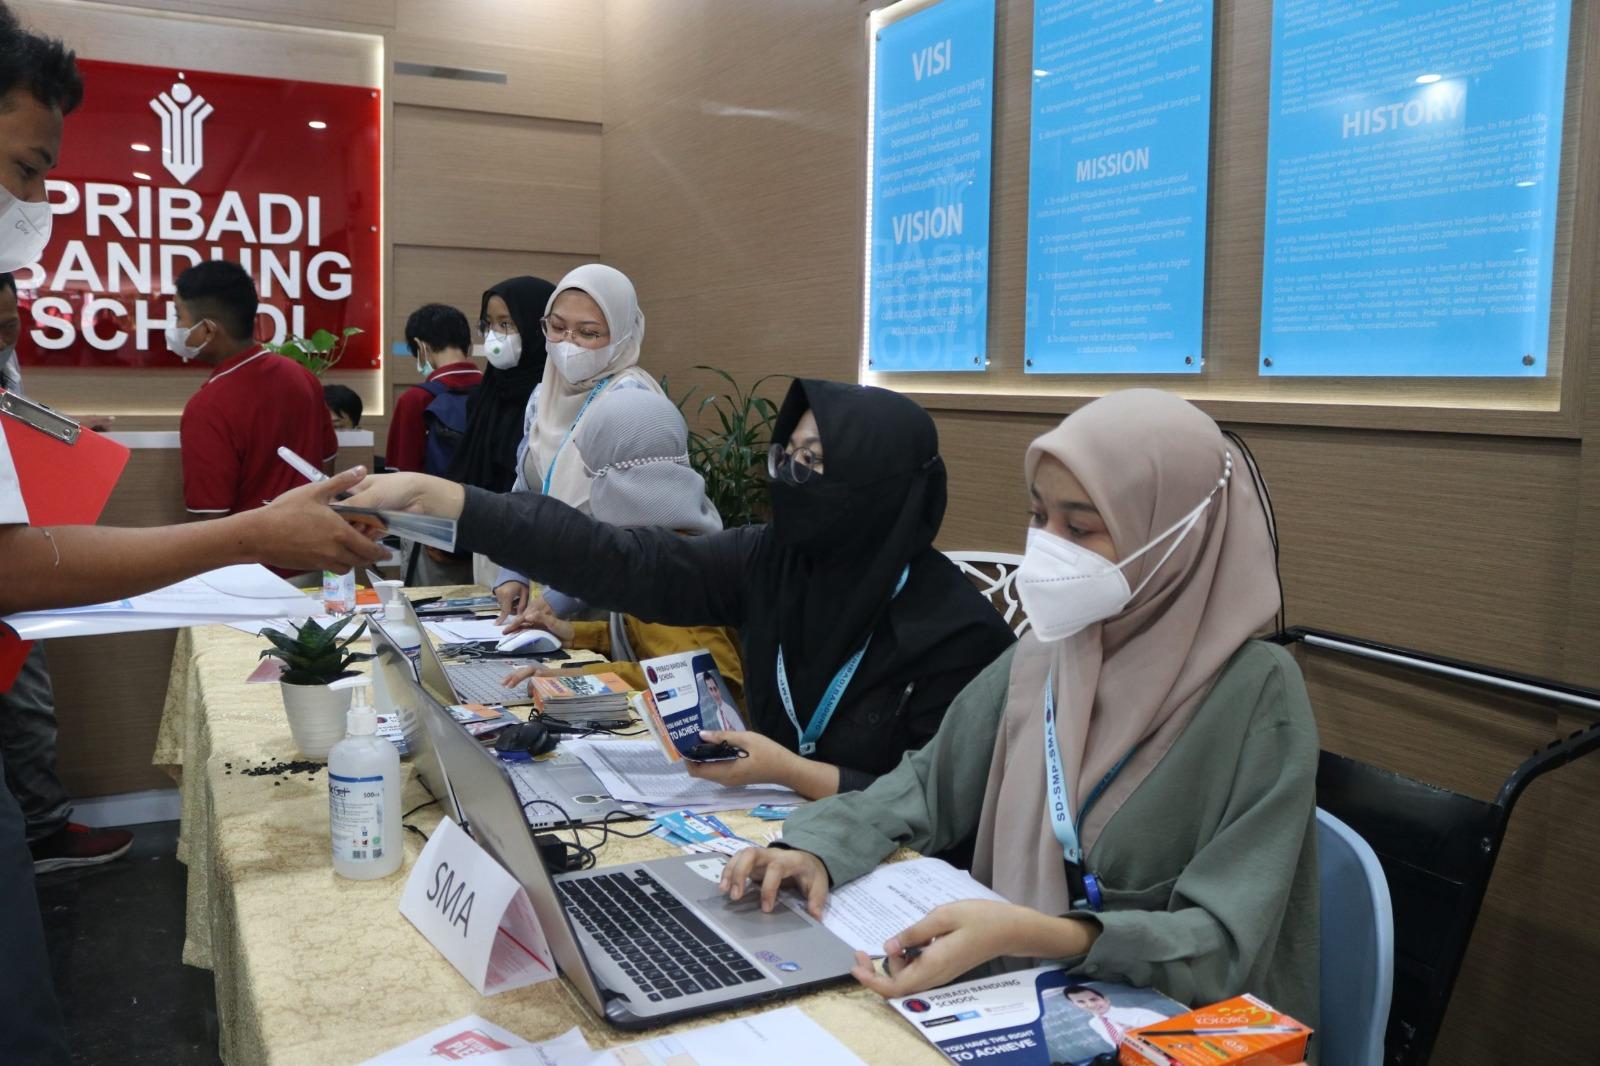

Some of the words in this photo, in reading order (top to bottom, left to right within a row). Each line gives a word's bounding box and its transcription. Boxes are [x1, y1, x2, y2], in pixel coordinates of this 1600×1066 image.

[912, 39, 952, 81] VISI
[1342, 91, 1463, 139] HISTORY
[1076, 146, 1149, 183] MISSION
[45, 180, 320, 246] PRIBADI
[892, 203, 963, 245] VISION
[14, 241, 352, 300] ANDNG
[30, 297, 325, 352] SCHOL
[670, 731, 678, 740] TO
[678, 723, 700, 738] ACHIEVE
[427, 862, 476, 938] SMA
[929, 987, 970, 1002] PRIBADI
[970, 979, 1021, 993] BANDUNG
[935, 995, 979, 1009] SCHOOL
[944, 1042, 966, 1053] YOU
[965, 1038, 990, 1050] HAVE
[990, 1034, 1008, 1045] THE
[1008, 1029, 1035, 1040] RIGHT
[951, 1051, 974, 1063] TO
[977, 1038, 1037, 1058] ACHIEVE
